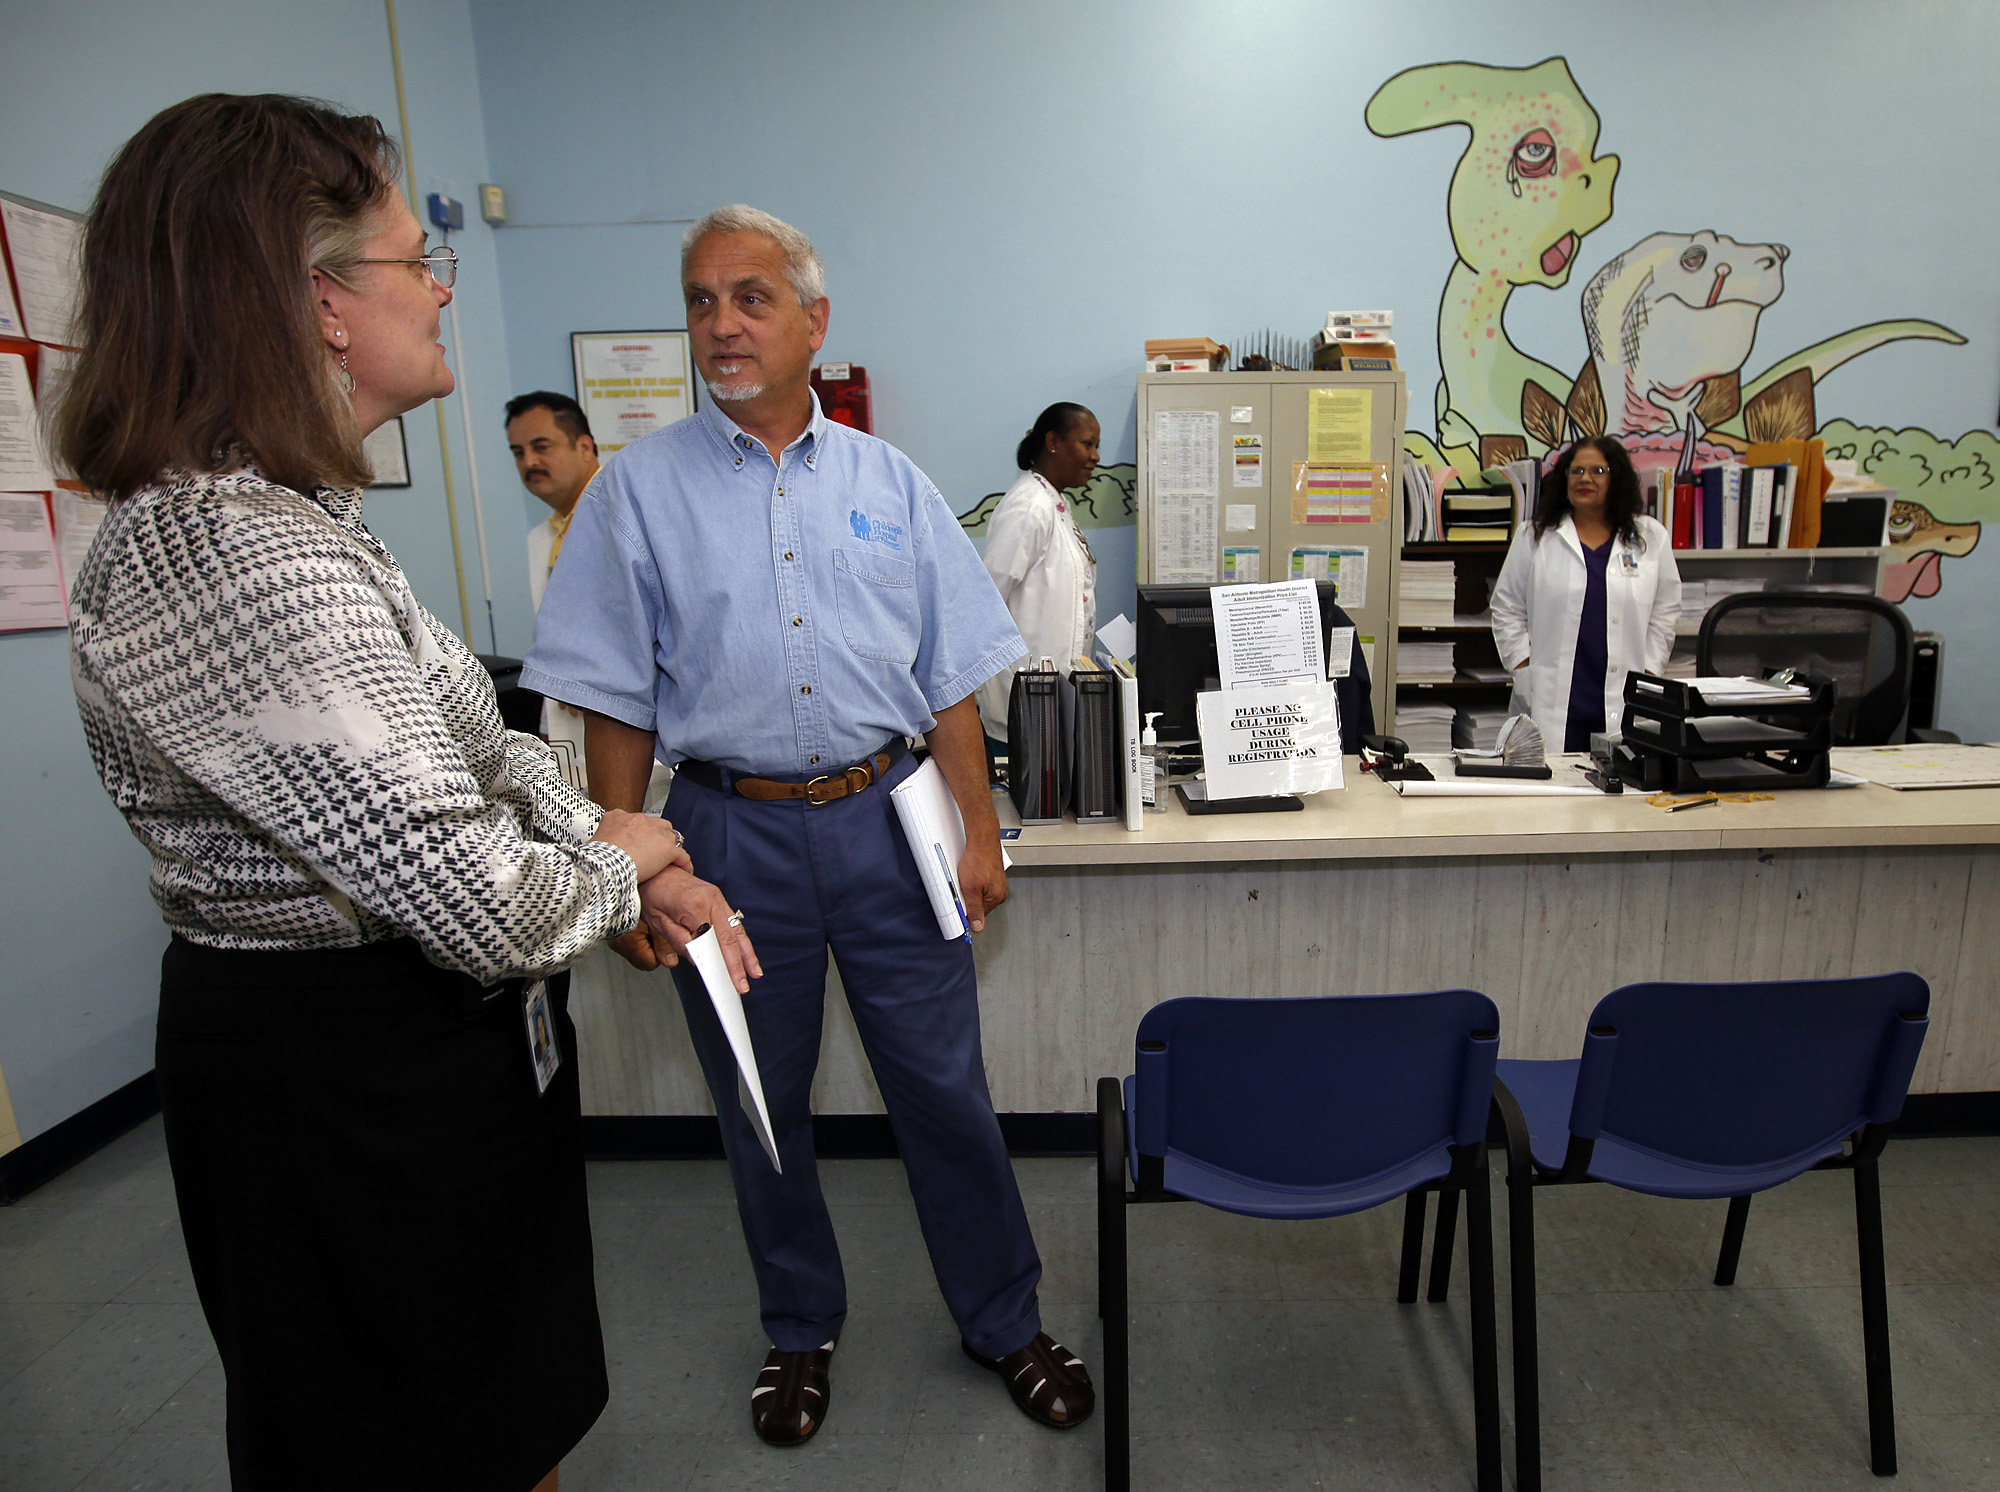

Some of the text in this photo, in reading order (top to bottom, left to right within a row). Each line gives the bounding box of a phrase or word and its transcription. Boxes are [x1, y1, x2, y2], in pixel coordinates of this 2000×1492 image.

[1235, 705, 1280, 716] PLEASE
[1230, 716, 1308, 728] CELL PHONE
[1252, 727, 1290, 738] USAGE
[1249, 738, 1296, 749] DURING
